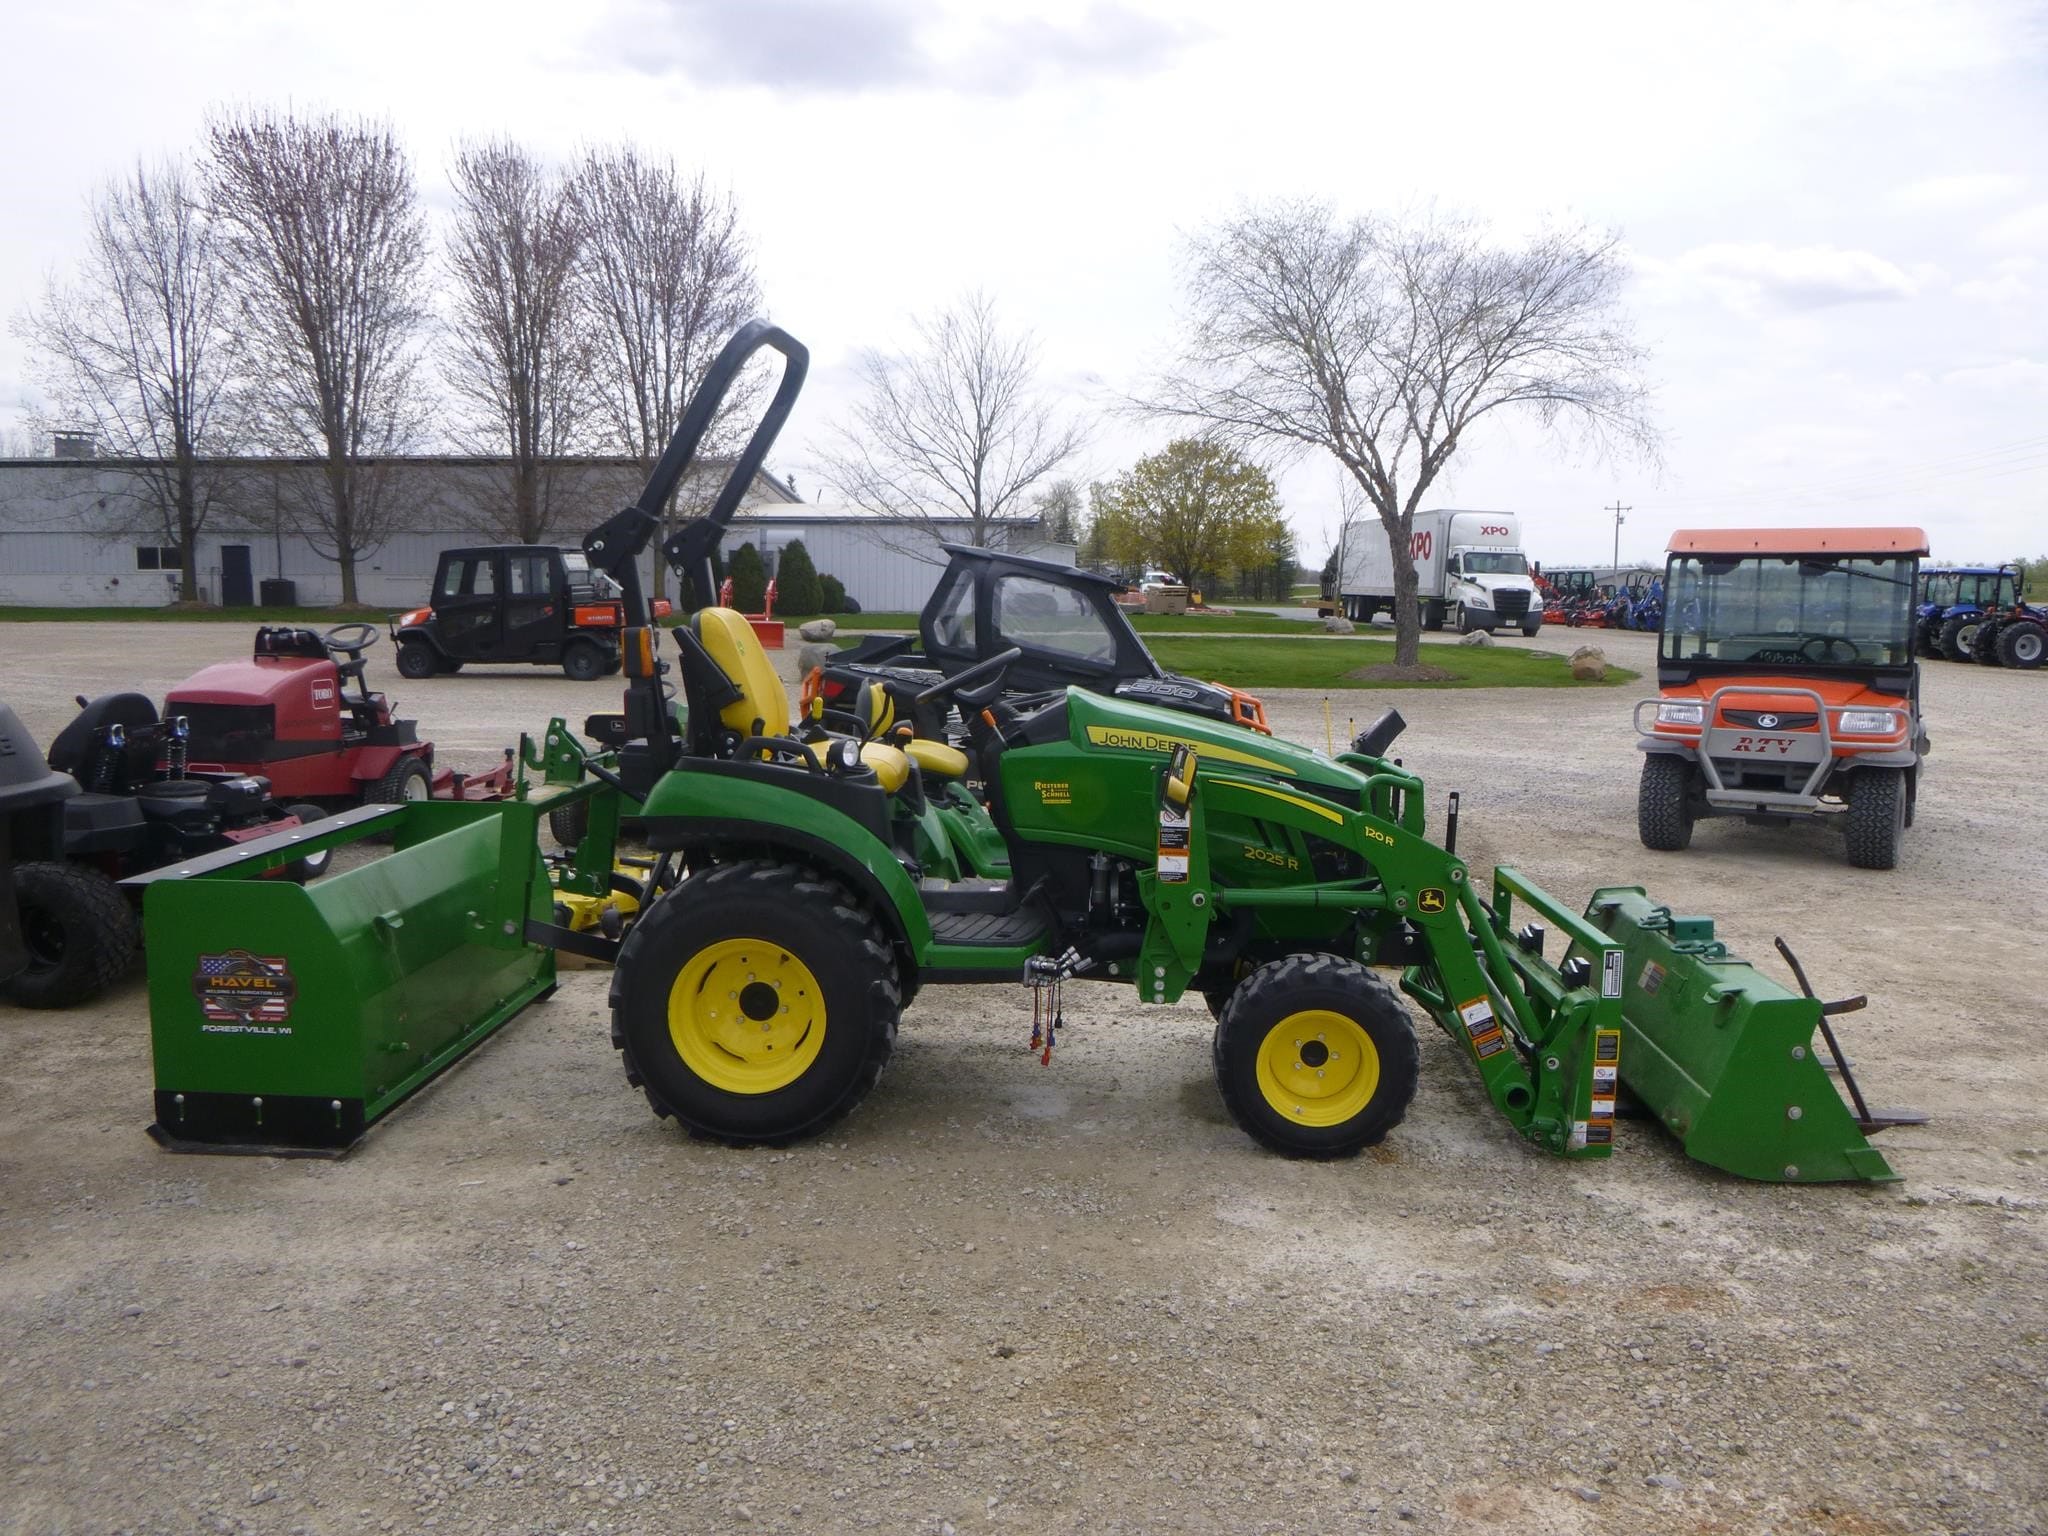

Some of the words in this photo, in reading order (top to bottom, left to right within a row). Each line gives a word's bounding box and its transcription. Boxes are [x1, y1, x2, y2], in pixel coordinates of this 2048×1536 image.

[1481, 526, 1509, 536] XPO
[1409, 531, 1432, 560] XPO
[313, 688, 333, 700] TORO
[1100, 732, 1142, 748] JOHN
[1146, 735, 1198, 754] DEEE
[1732, 737, 1797, 754] RTV
[1364, 826, 1384, 842] 120
[1386, 836, 1395, 847] R
[1245, 846, 1285, 866] 2025
[1287, 857, 1299, 871] R
[211, 976, 277, 988] HAVEL
[202, 1025, 277, 1035] FORESTVILLE,
